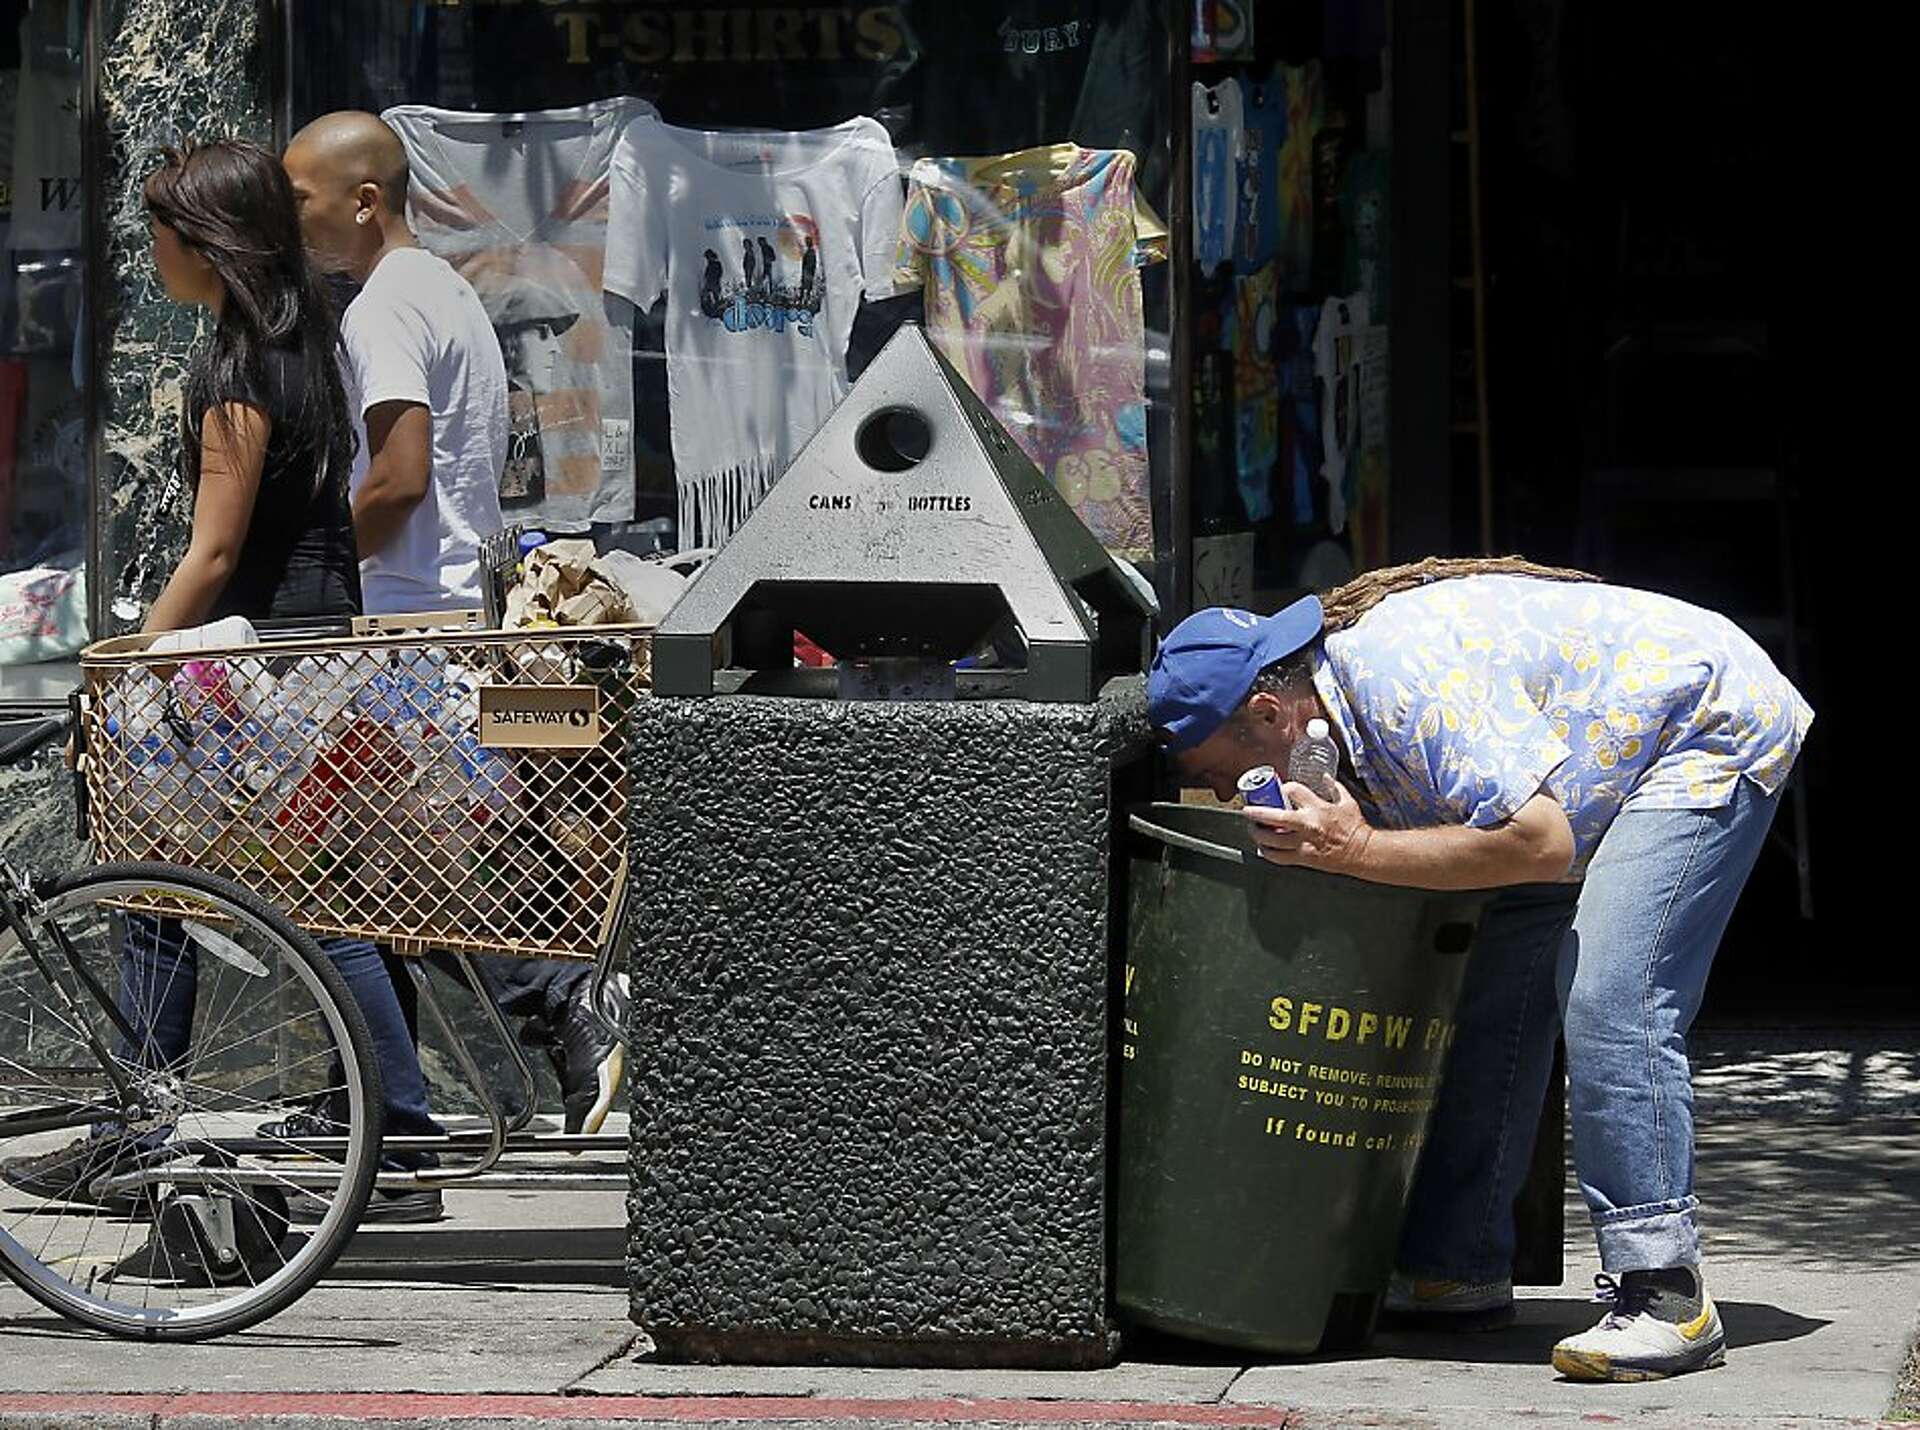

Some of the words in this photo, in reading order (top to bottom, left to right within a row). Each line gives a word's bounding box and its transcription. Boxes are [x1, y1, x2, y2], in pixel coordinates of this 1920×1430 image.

[554, 7, 904, 63] T-SHIRTS
[809, 494, 852, 510] CANS
[908, 495, 972, 511] BOTTLES
[492, 710, 567, 724] SAFEWAY
[1268, 996, 1413, 1050] SFDPW
[1241, 1050, 1263, 1067] DO
[1269, 1056, 1302, 1074] NOT
[1238, 1074, 1308, 1101] SUBJECT
[1315, 1090, 1344, 1107] YOU
[1351, 1096, 1368, 1111] TO
[1265, 1116, 1286, 1136] If
[1295, 1122, 1357, 1148] found
